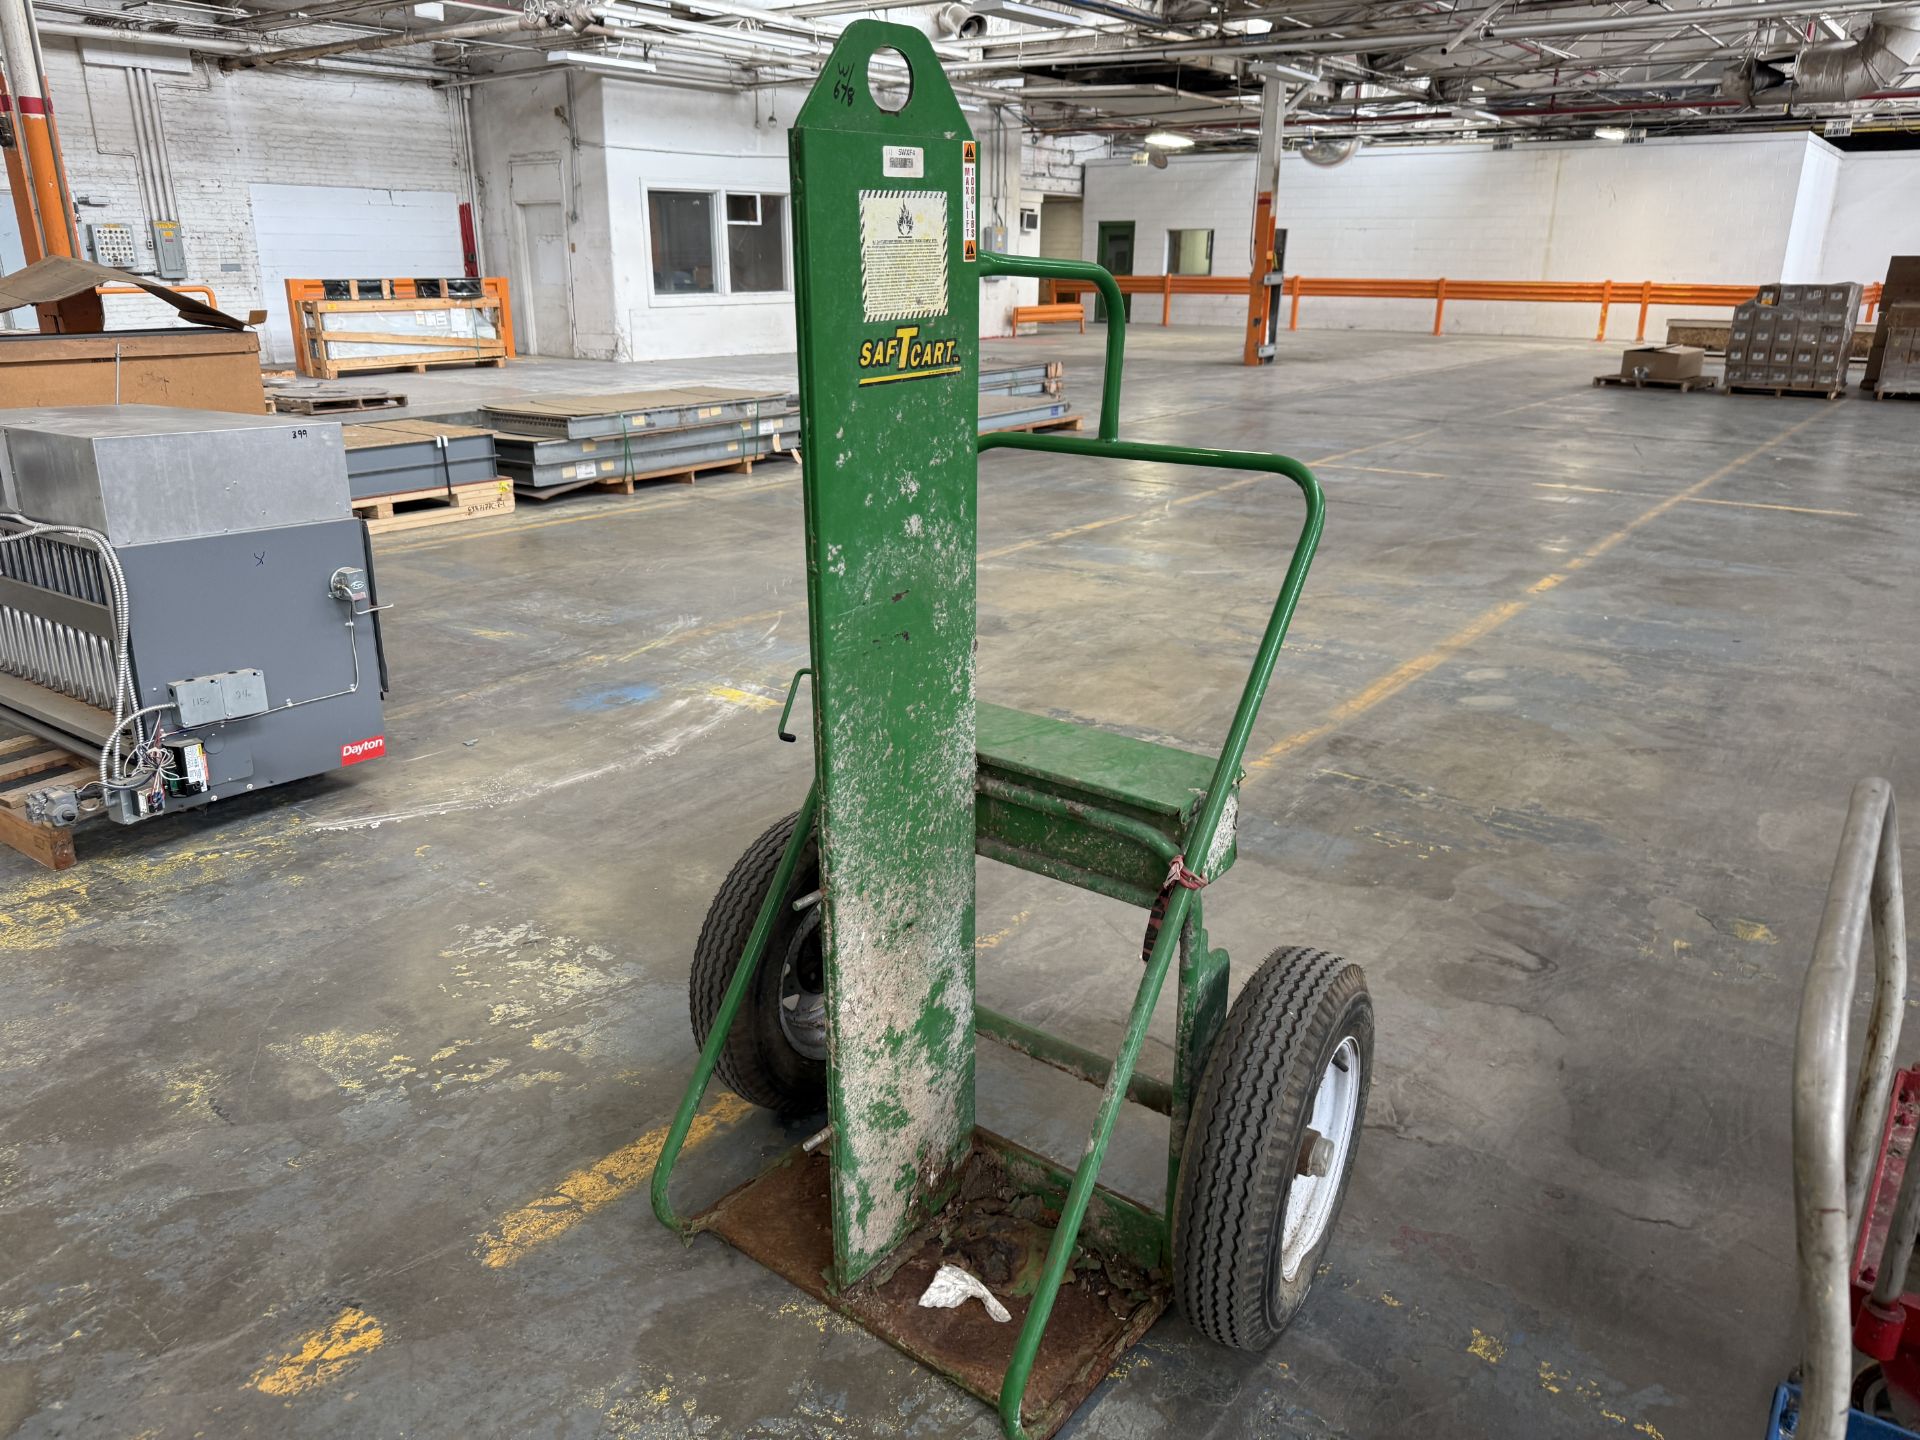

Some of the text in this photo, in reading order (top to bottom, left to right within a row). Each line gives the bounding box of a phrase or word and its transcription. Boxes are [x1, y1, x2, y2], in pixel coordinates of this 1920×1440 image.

[833, 79, 856, 107] 678
[291, 429, 308, 439] 399
[342, 738, 383, 757] Dayton
